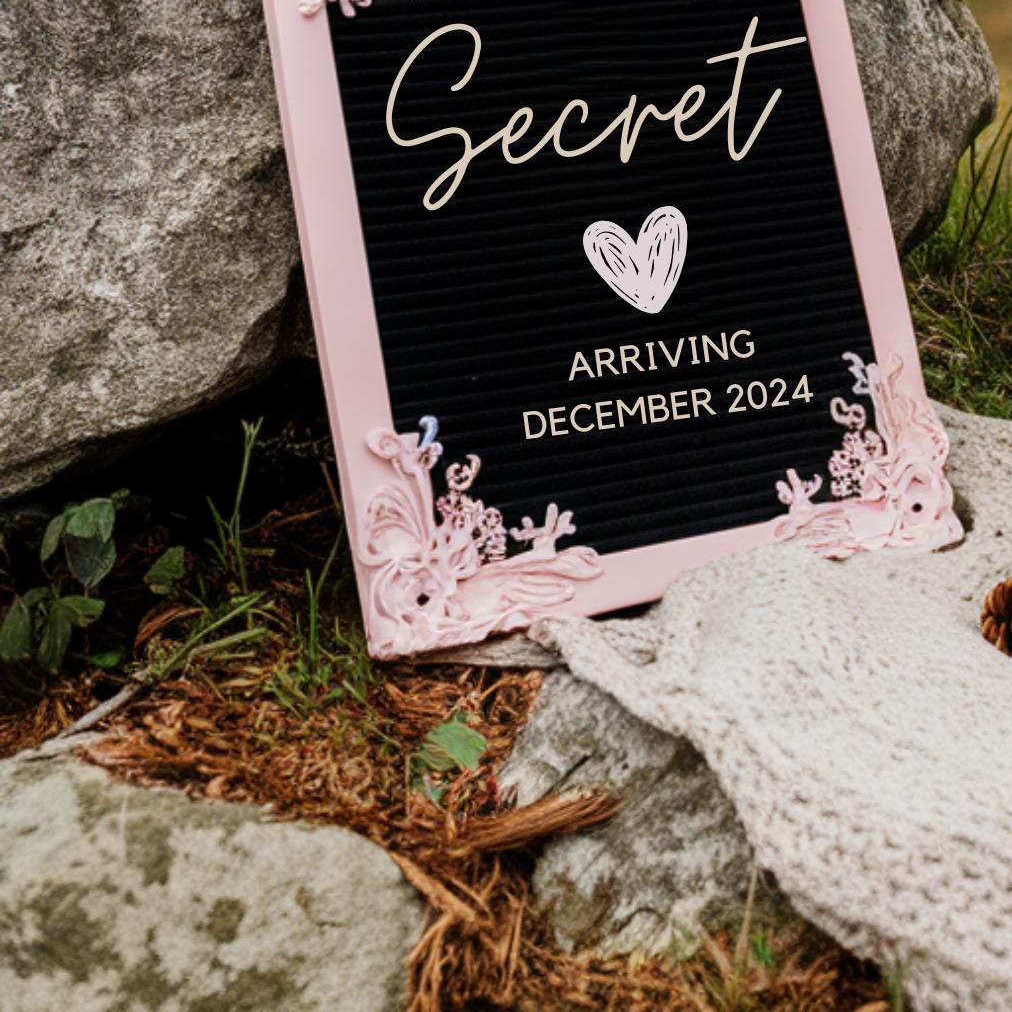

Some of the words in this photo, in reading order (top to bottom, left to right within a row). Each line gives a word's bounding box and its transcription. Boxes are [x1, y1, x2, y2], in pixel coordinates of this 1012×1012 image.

[386, 16, 806, 210] Secret
[569, 330, 754, 381] ARRIVING
[523, 389, 716, 439] DECEMBER
[727, 375, 813, 412] 2024
